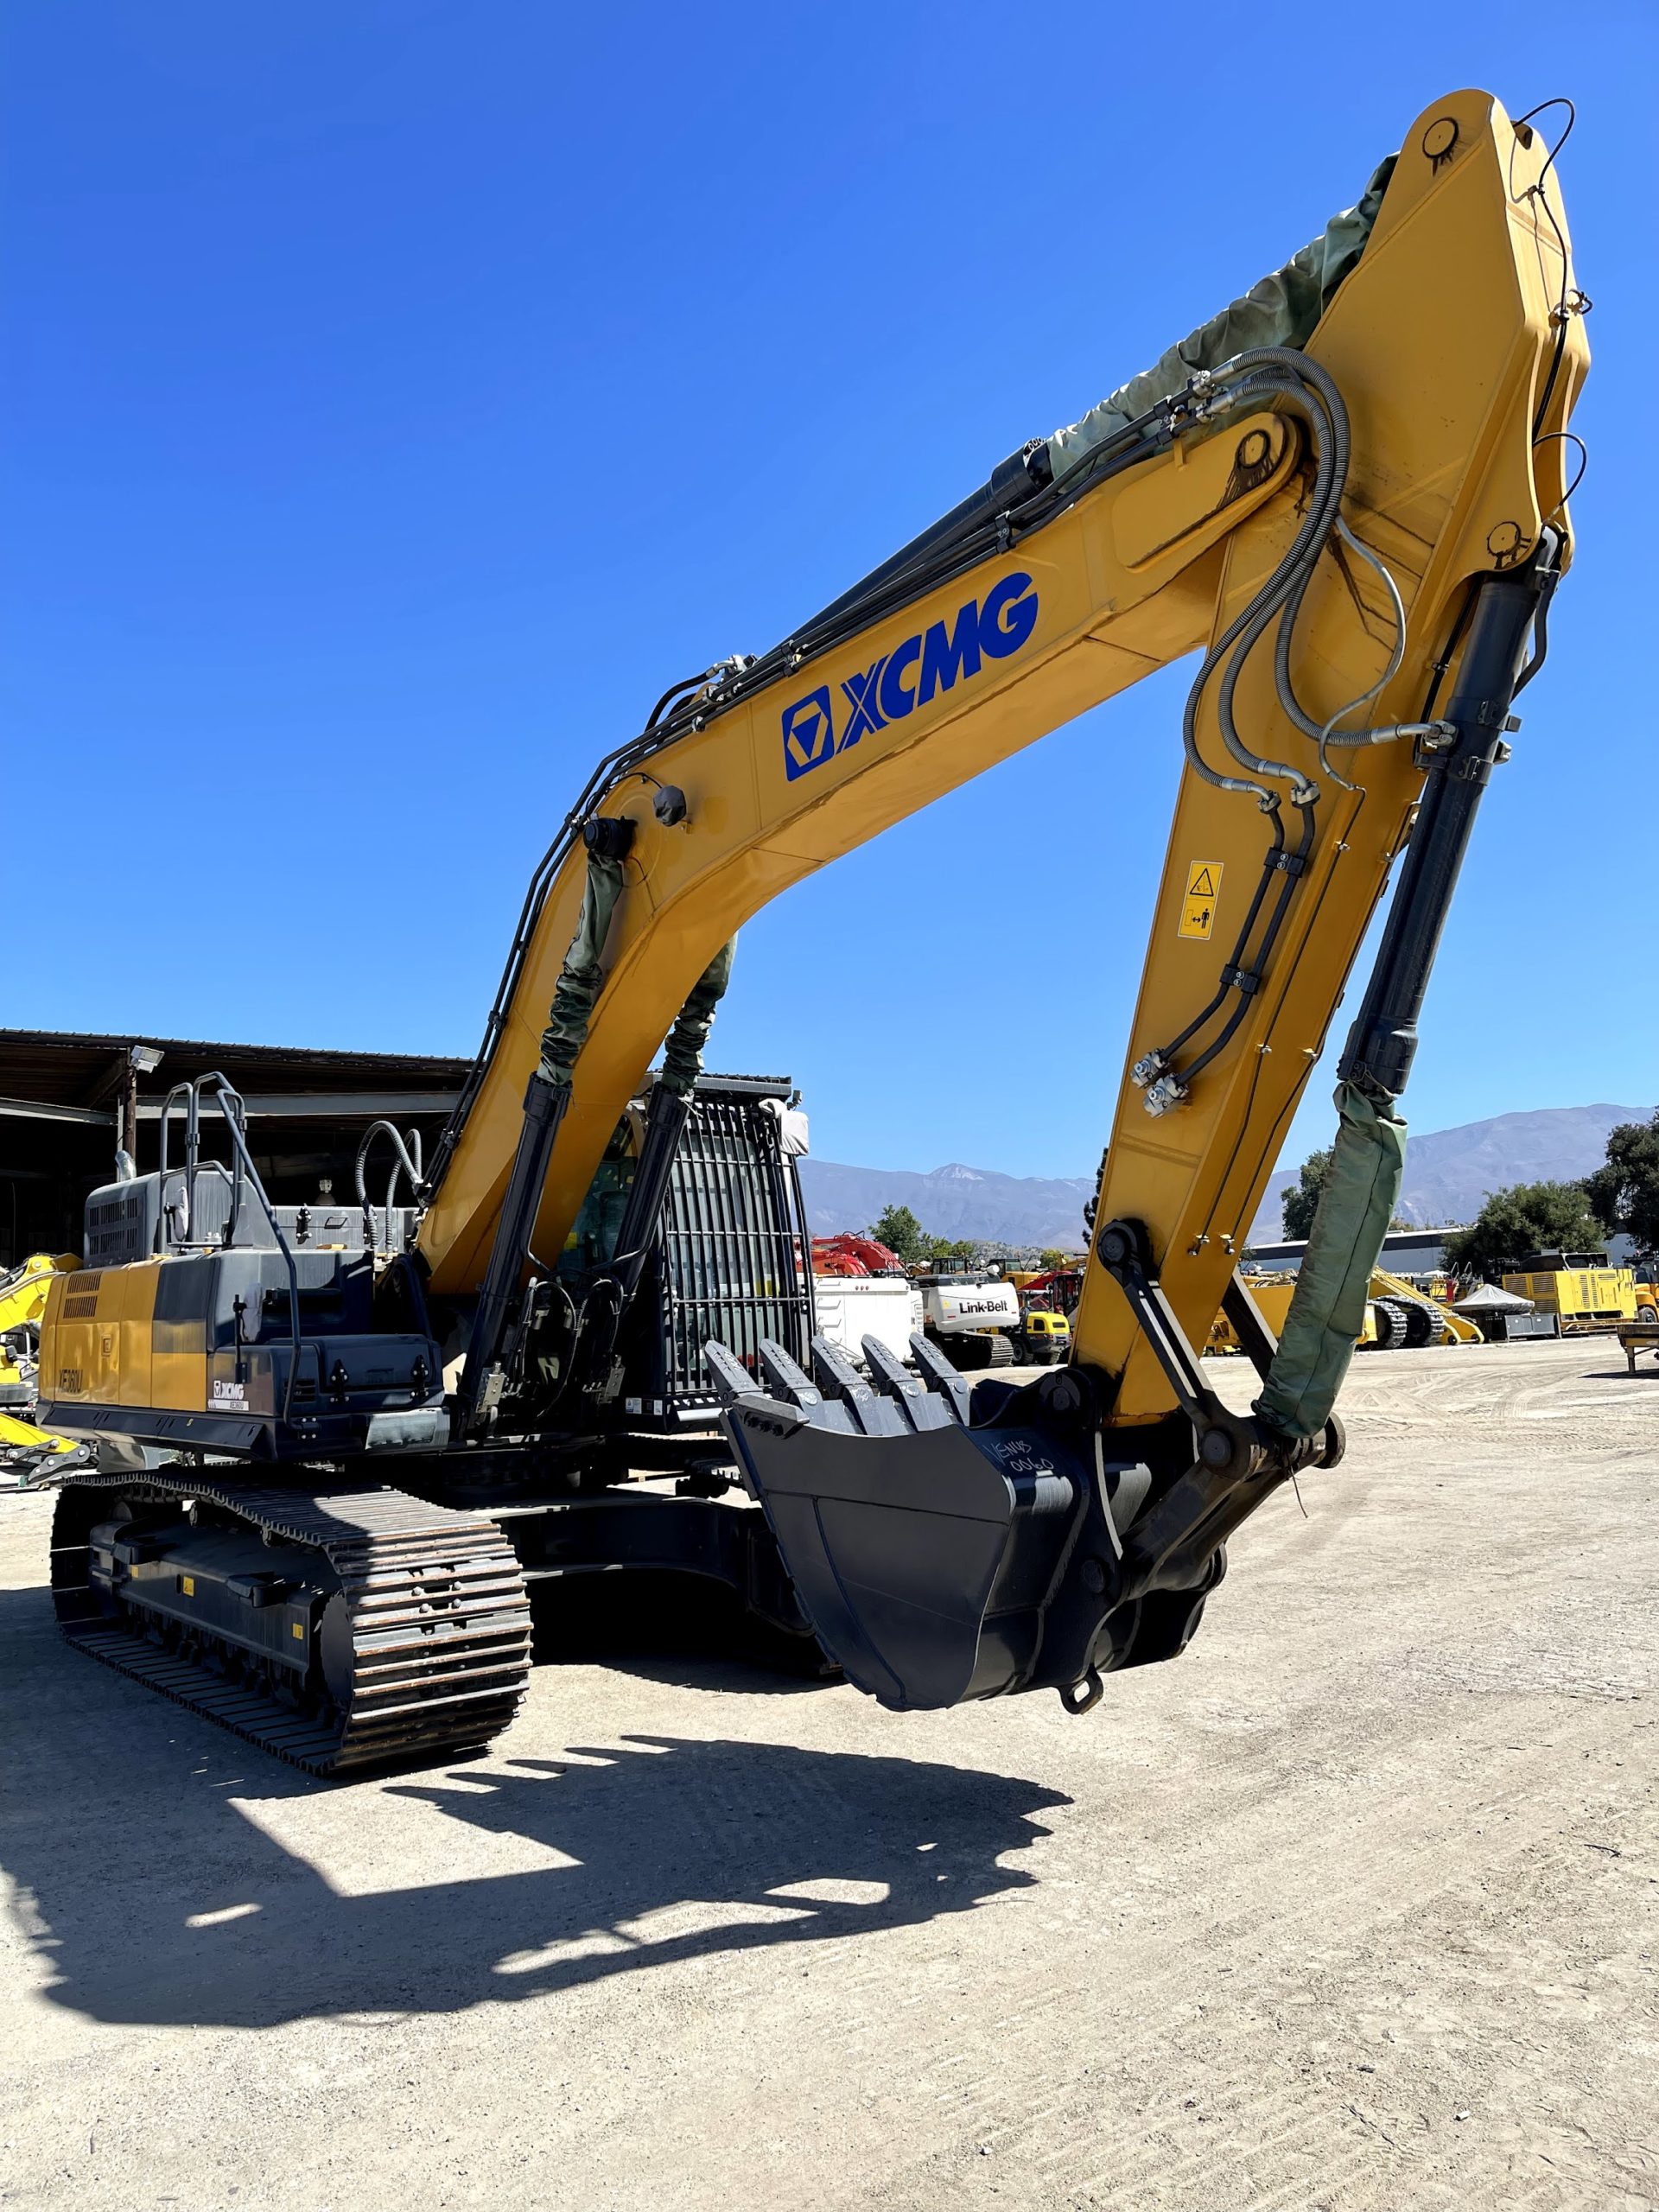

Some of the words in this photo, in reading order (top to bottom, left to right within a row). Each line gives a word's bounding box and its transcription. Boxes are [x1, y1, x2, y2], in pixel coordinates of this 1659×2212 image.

[836, 572, 1039, 754] XCMG
[959, 1300, 1007, 1313] Link-Belt
[220, 1382, 244, 1400] XCMG
[1010, 1458, 1053, 1471] 0060
